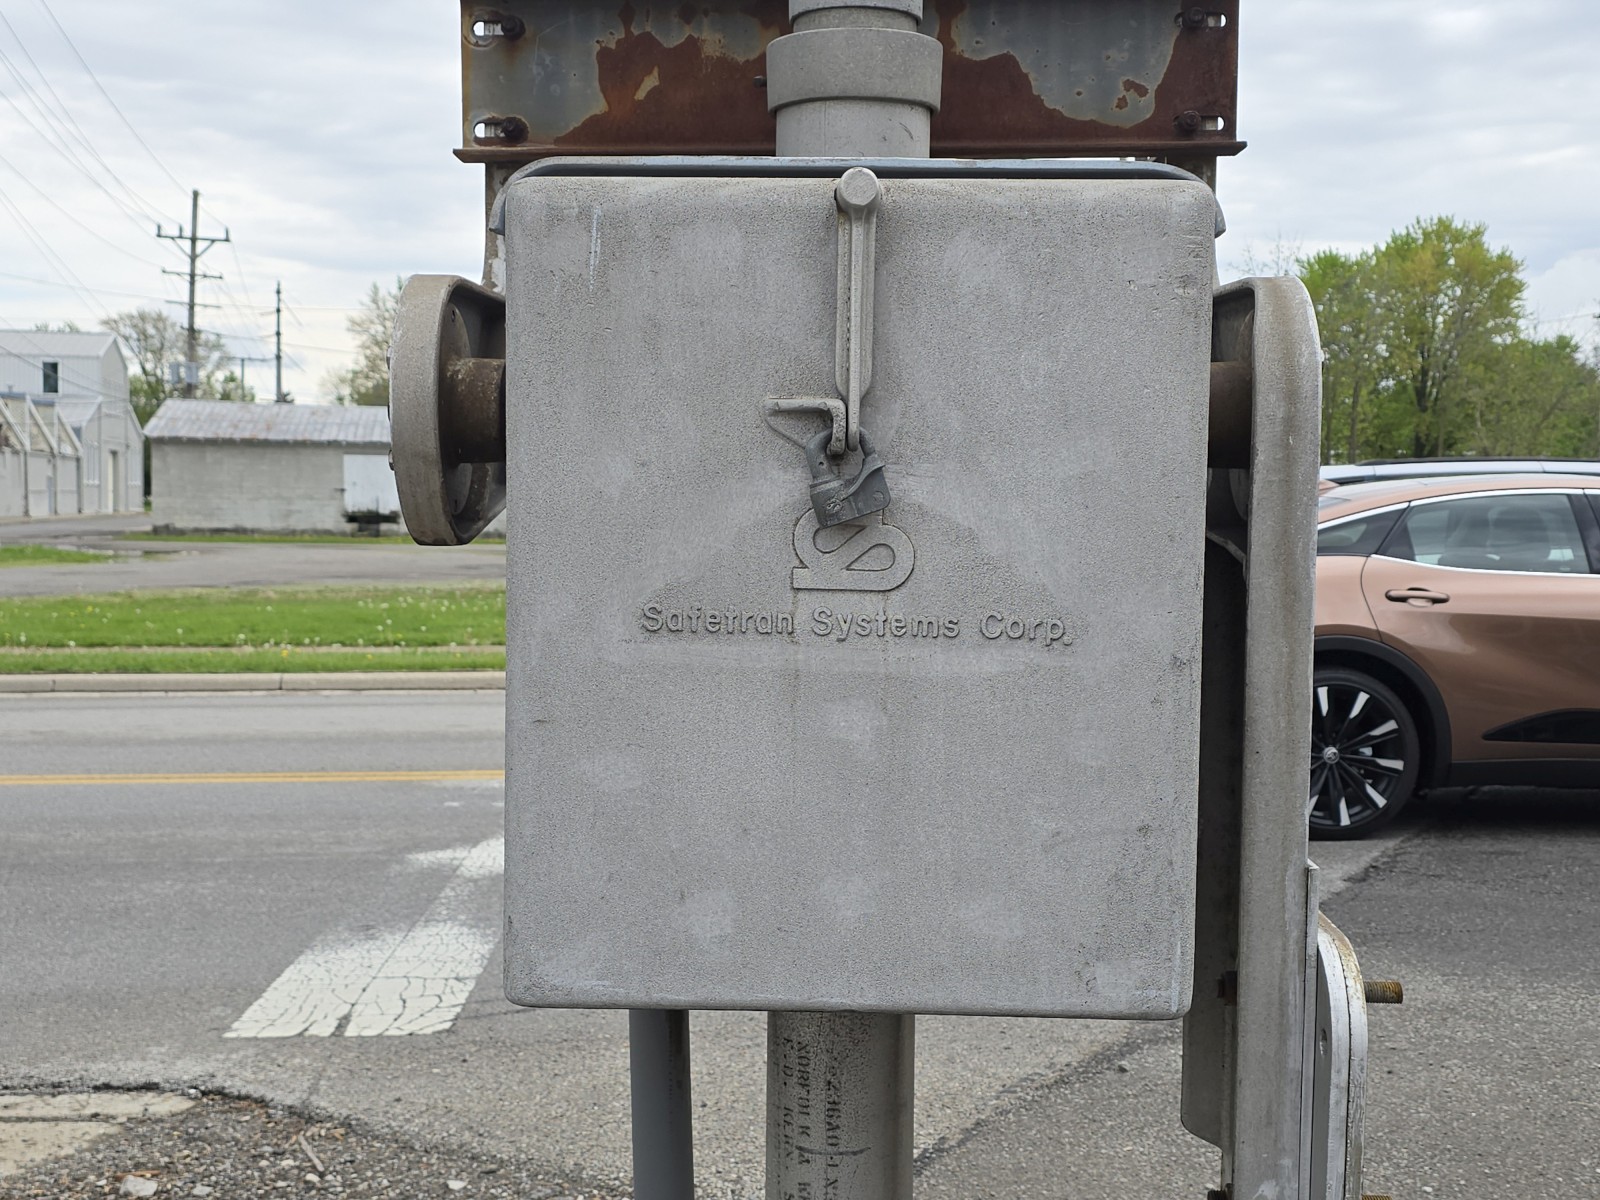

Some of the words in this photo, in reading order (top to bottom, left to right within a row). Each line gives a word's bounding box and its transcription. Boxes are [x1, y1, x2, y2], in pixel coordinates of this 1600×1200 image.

[641, 602, 794, 635] Safetran
[811, 605, 960, 642] Systems
[980, 610, 1073, 648] Corp.
